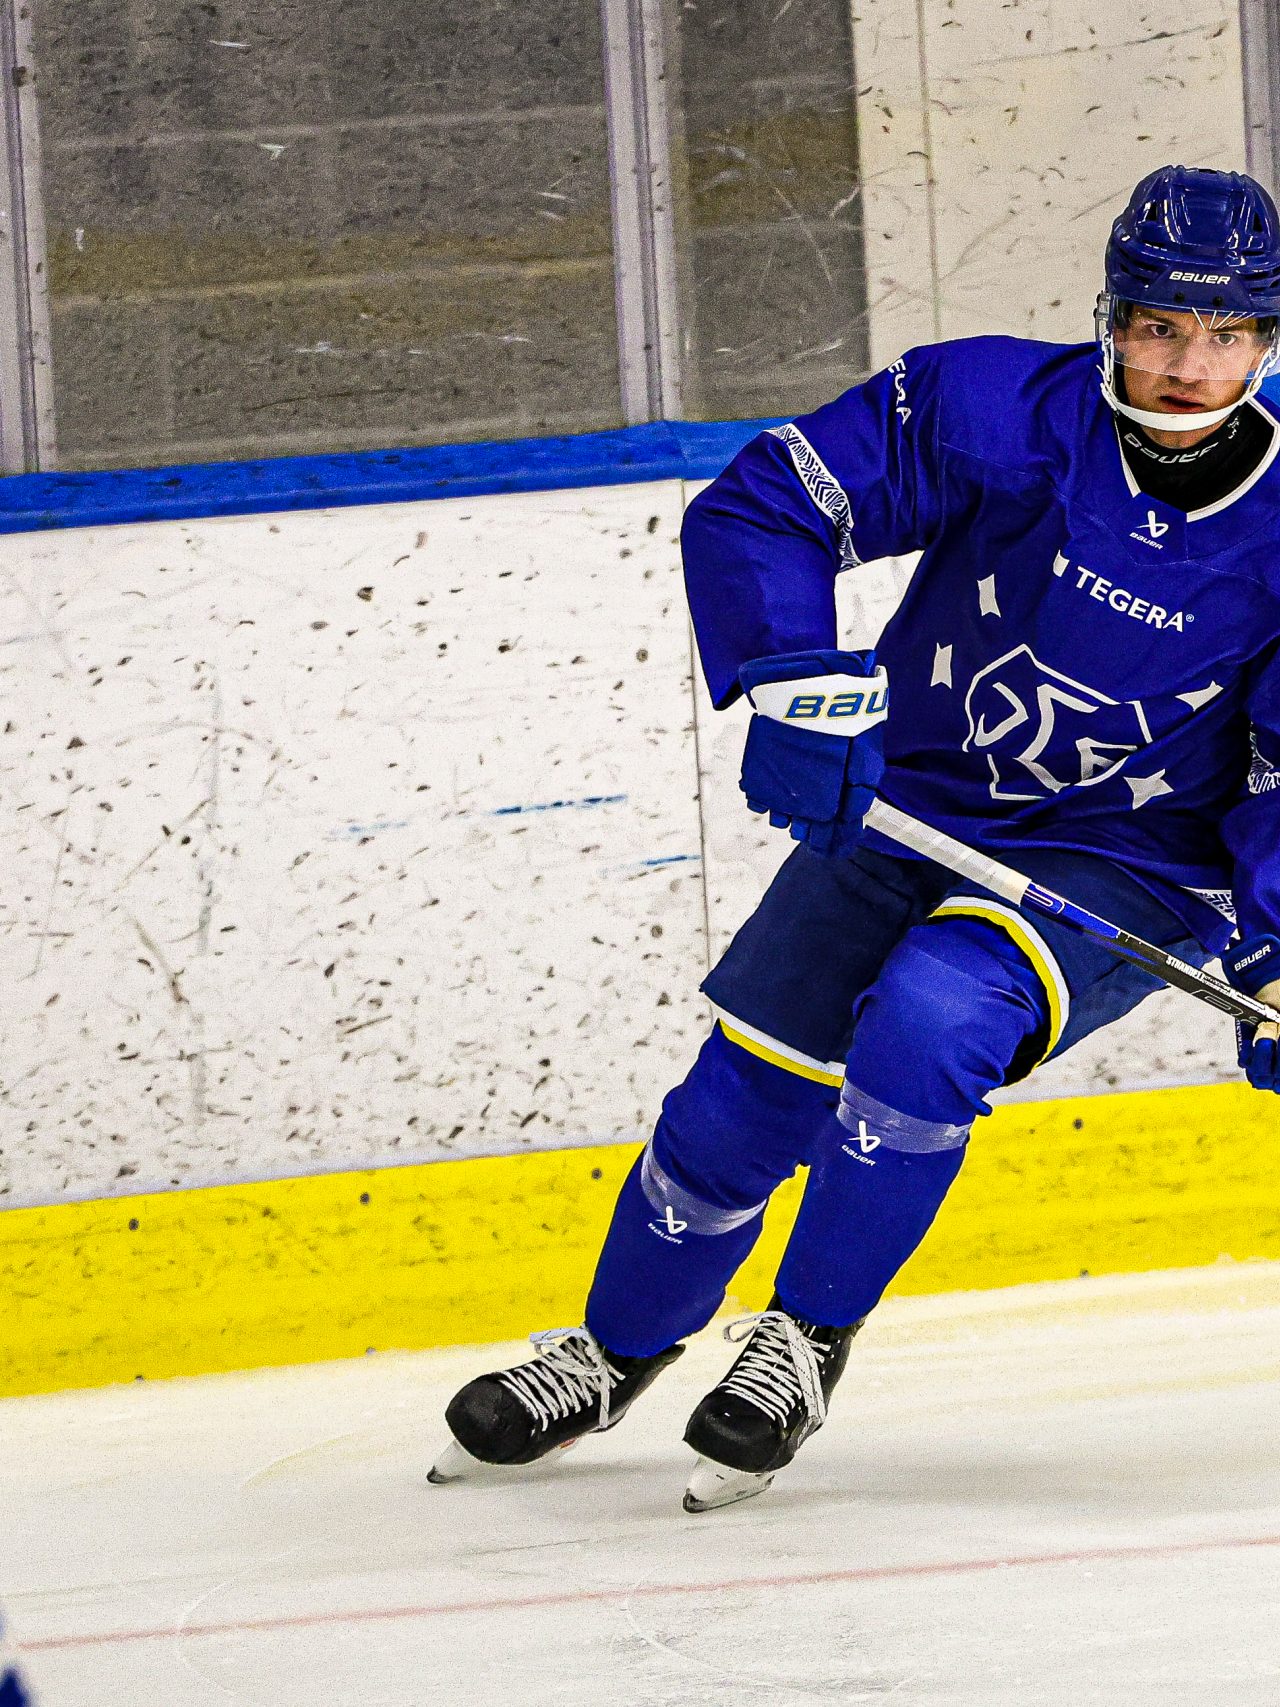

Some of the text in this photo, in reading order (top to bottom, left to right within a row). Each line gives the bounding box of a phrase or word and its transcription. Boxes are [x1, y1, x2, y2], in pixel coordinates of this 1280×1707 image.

[1169, 271, 1231, 285] BAUER
[1129, 532, 1164, 550] BAUER
[1234, 944, 1272, 972] BAUER
[841, 1144, 876, 1167] BAUER
